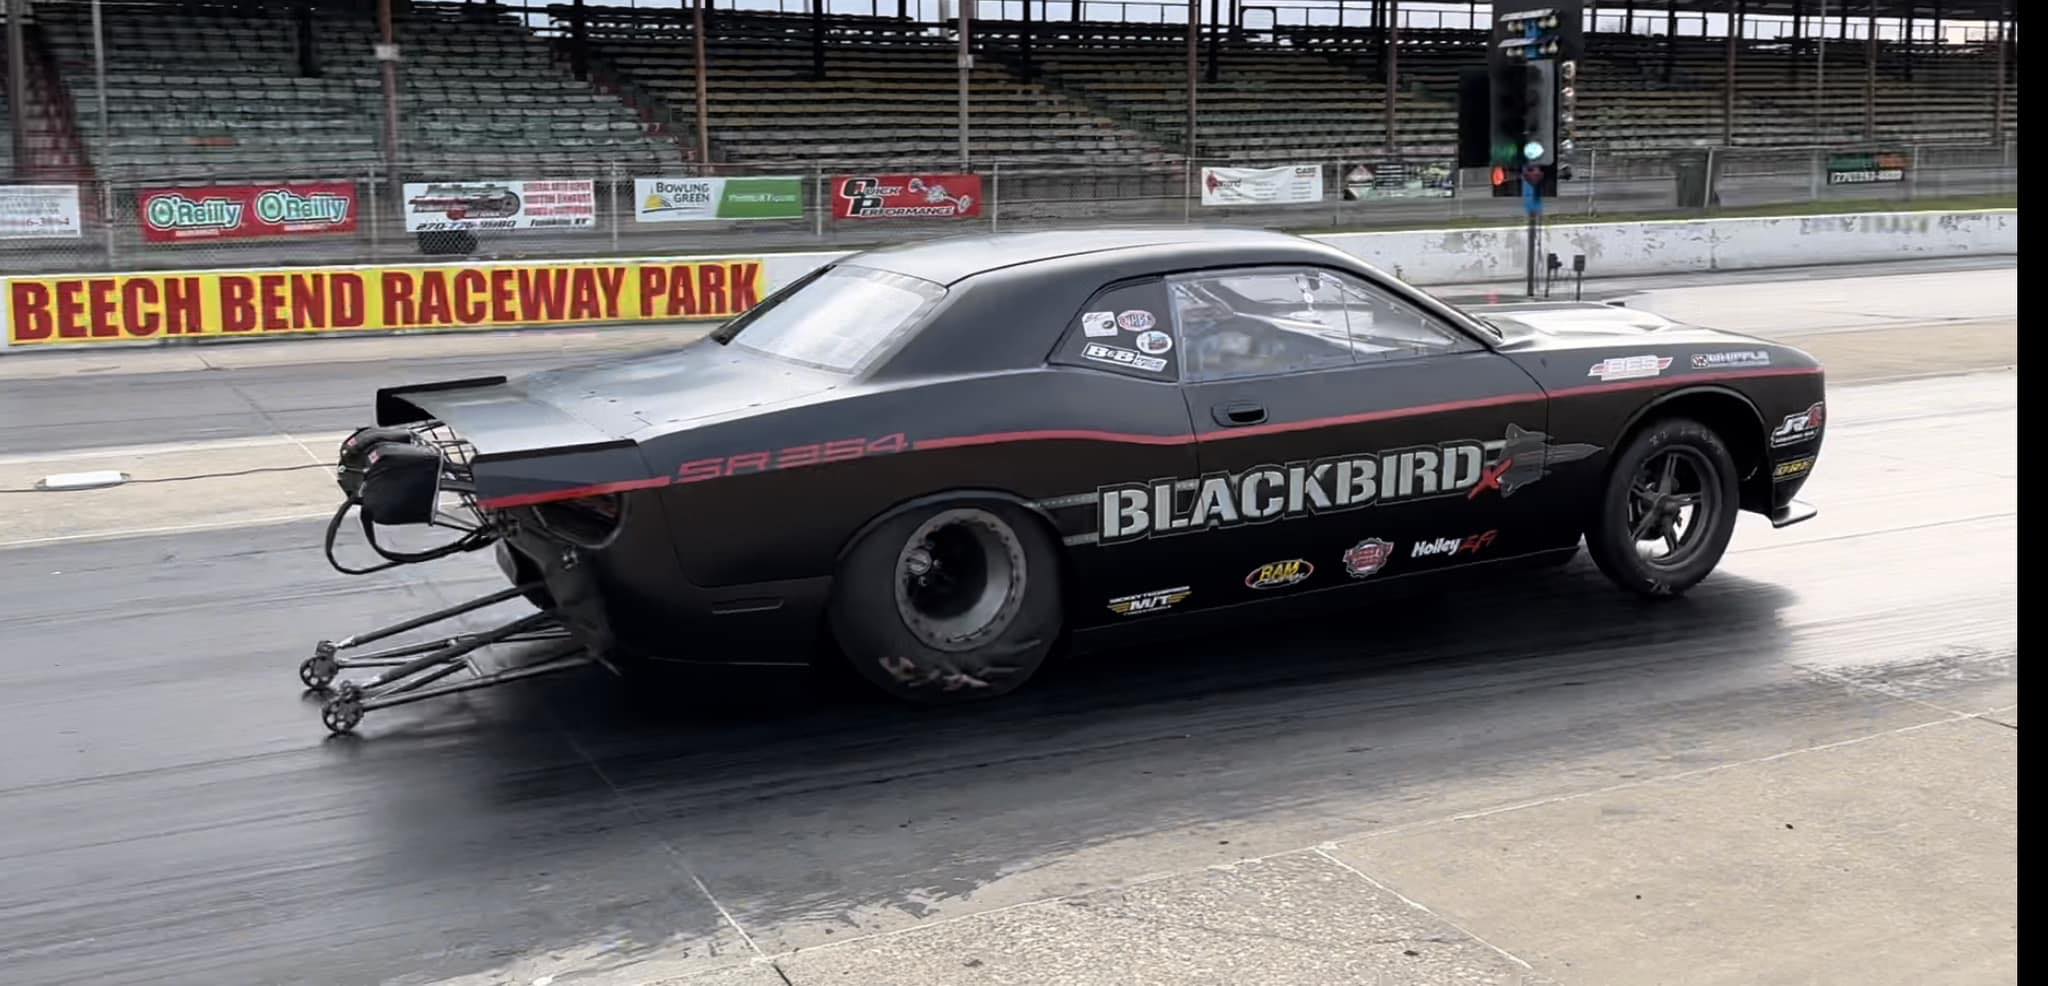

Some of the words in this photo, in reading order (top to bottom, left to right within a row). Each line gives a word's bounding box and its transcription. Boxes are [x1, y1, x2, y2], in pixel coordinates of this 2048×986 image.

[656, 182, 709, 193] BOWLING
[841, 177, 902, 197] QUICK
[257, 190, 349, 222] O'Reilly
[674, 193, 709, 203] GREEN
[847, 196, 955, 217] PERFORMANCE
[149, 195, 243, 228] O'Reilly
[12, 276, 200, 341] BEECH
[219, 272, 365, 333] BEND
[381, 266, 626, 326] RACEWAY
[640, 262, 760, 317] PARK
[1102, 443, 1484, 539] BLACKBIRD
[1410, 537, 1461, 558] Holley
[1259, 559, 1301, 581] RAM
